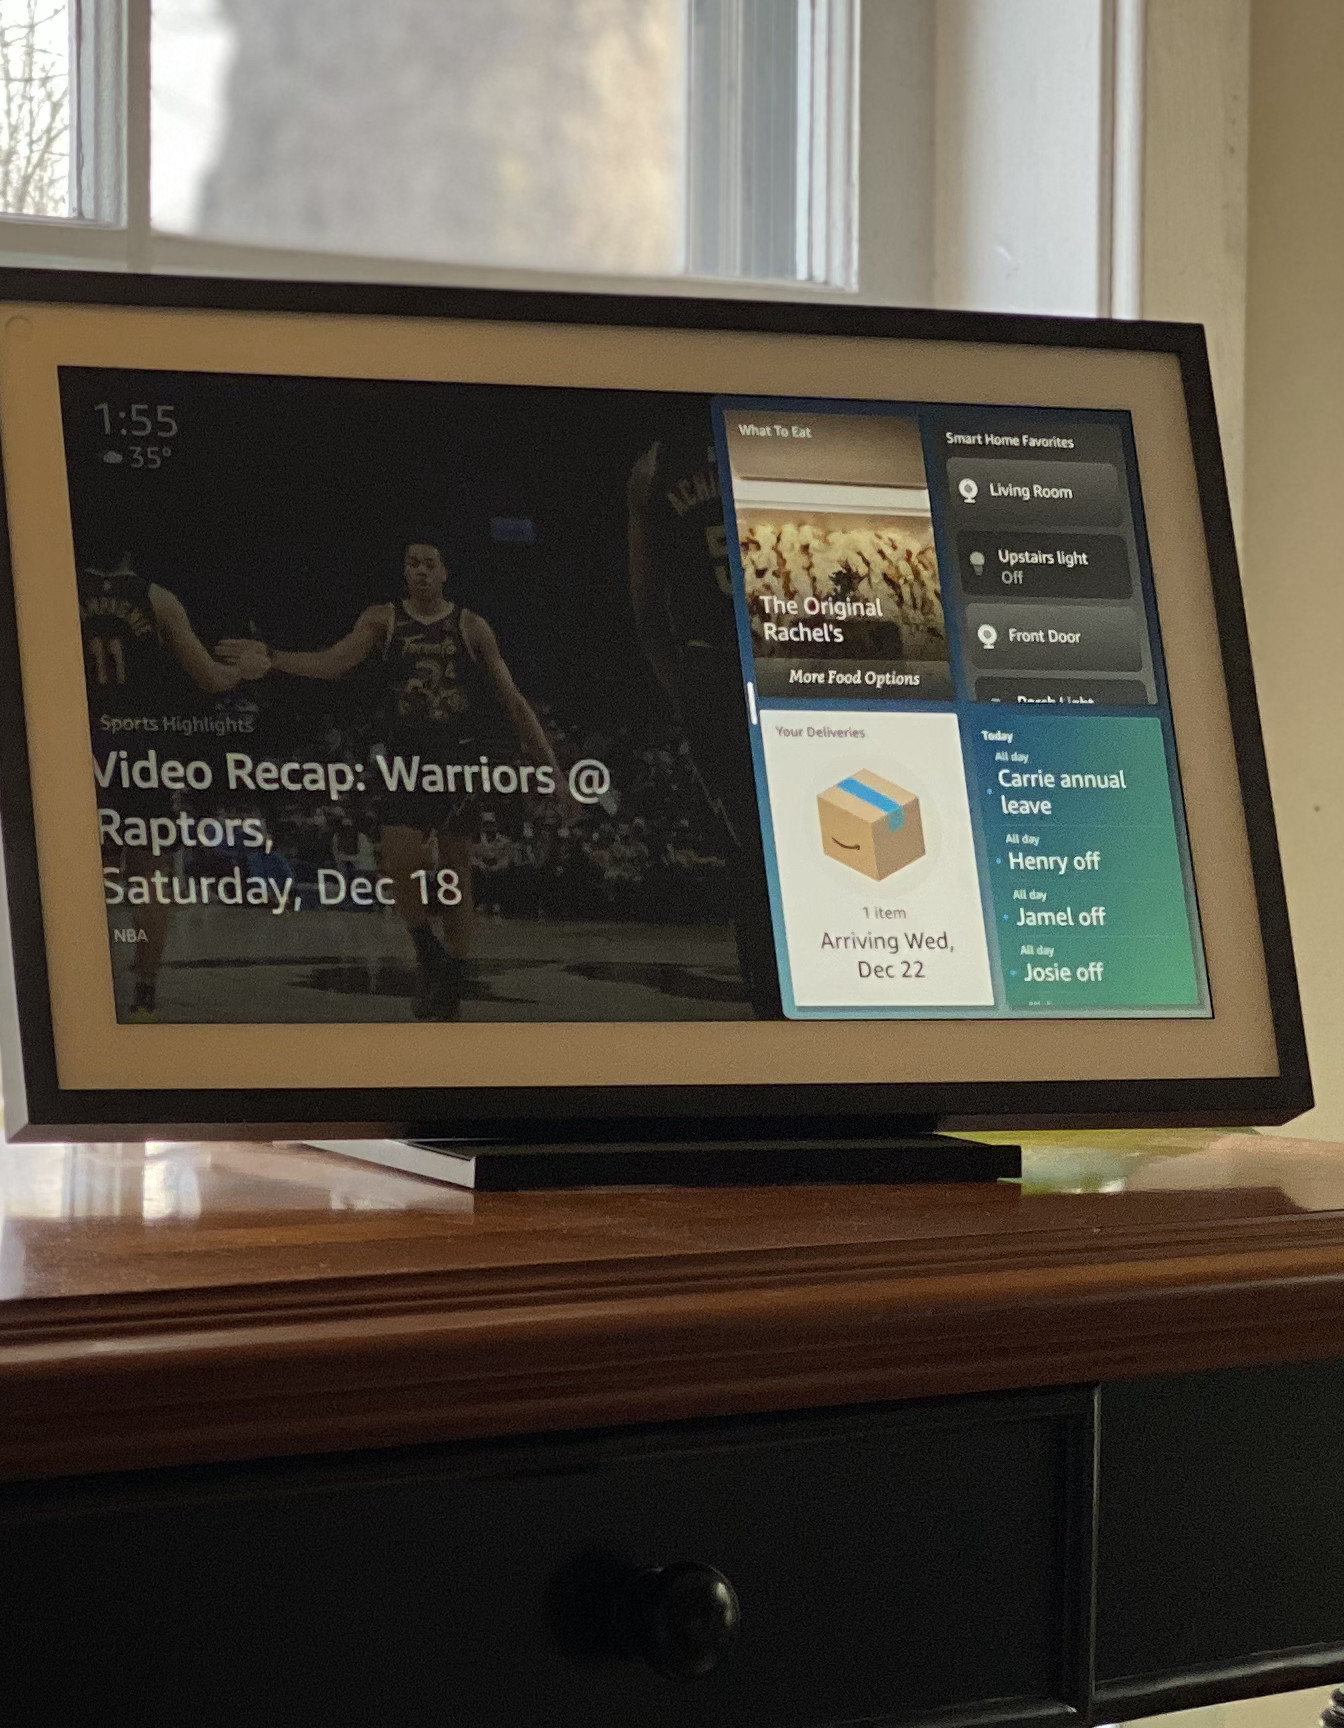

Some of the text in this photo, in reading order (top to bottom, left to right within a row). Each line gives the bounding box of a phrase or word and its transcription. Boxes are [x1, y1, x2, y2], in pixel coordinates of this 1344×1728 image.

[94, 403, 178, 437] 1:55
[739, 423, 811, 439] What To Eat
[946, 432, 1075, 449] Smart Home Favorites
[129, 447, 172, 469] 35°
[989, 482, 1074, 501] Living Room
[998, 549, 1088, 568] Upstairs light
[1001, 570, 1024, 585] Off
[760, 595, 883, 620] The Original
[764, 622, 844, 643] Rachel's
[1008, 628, 1081, 644] Front Door
[789, 669, 920, 688] More Food Options
[101, 714, 256, 736] Sports Highlights
[775, 725, 866, 739] Your Deliveries
[981, 730, 1013, 744] Today
[995, 751, 1029, 764] All day
[93, 749, 611, 805] Video Recap: Warriors @
[998, 769, 1127, 789] Carrie annual
[1000, 795, 1052, 815] leave
[97, 808, 274, 856] Raptors,
[1006, 833, 1040, 847] All day
[1008, 851, 1101, 875] Henry off
[102, 866, 463, 916] Saturday, Dec 18
[1013, 889, 1047, 902] All day
[863, 906, 907, 919] 1 item
[1016, 906, 1106, 926] Jamel off
[113, 928, 149, 944] NBA
[821, 931, 954, 954] Arriving Wed,
[1020, 944, 1054, 957] All day
[857, 960, 927, 979] Dec 22
[1024, 962, 1104, 982] Josie off
